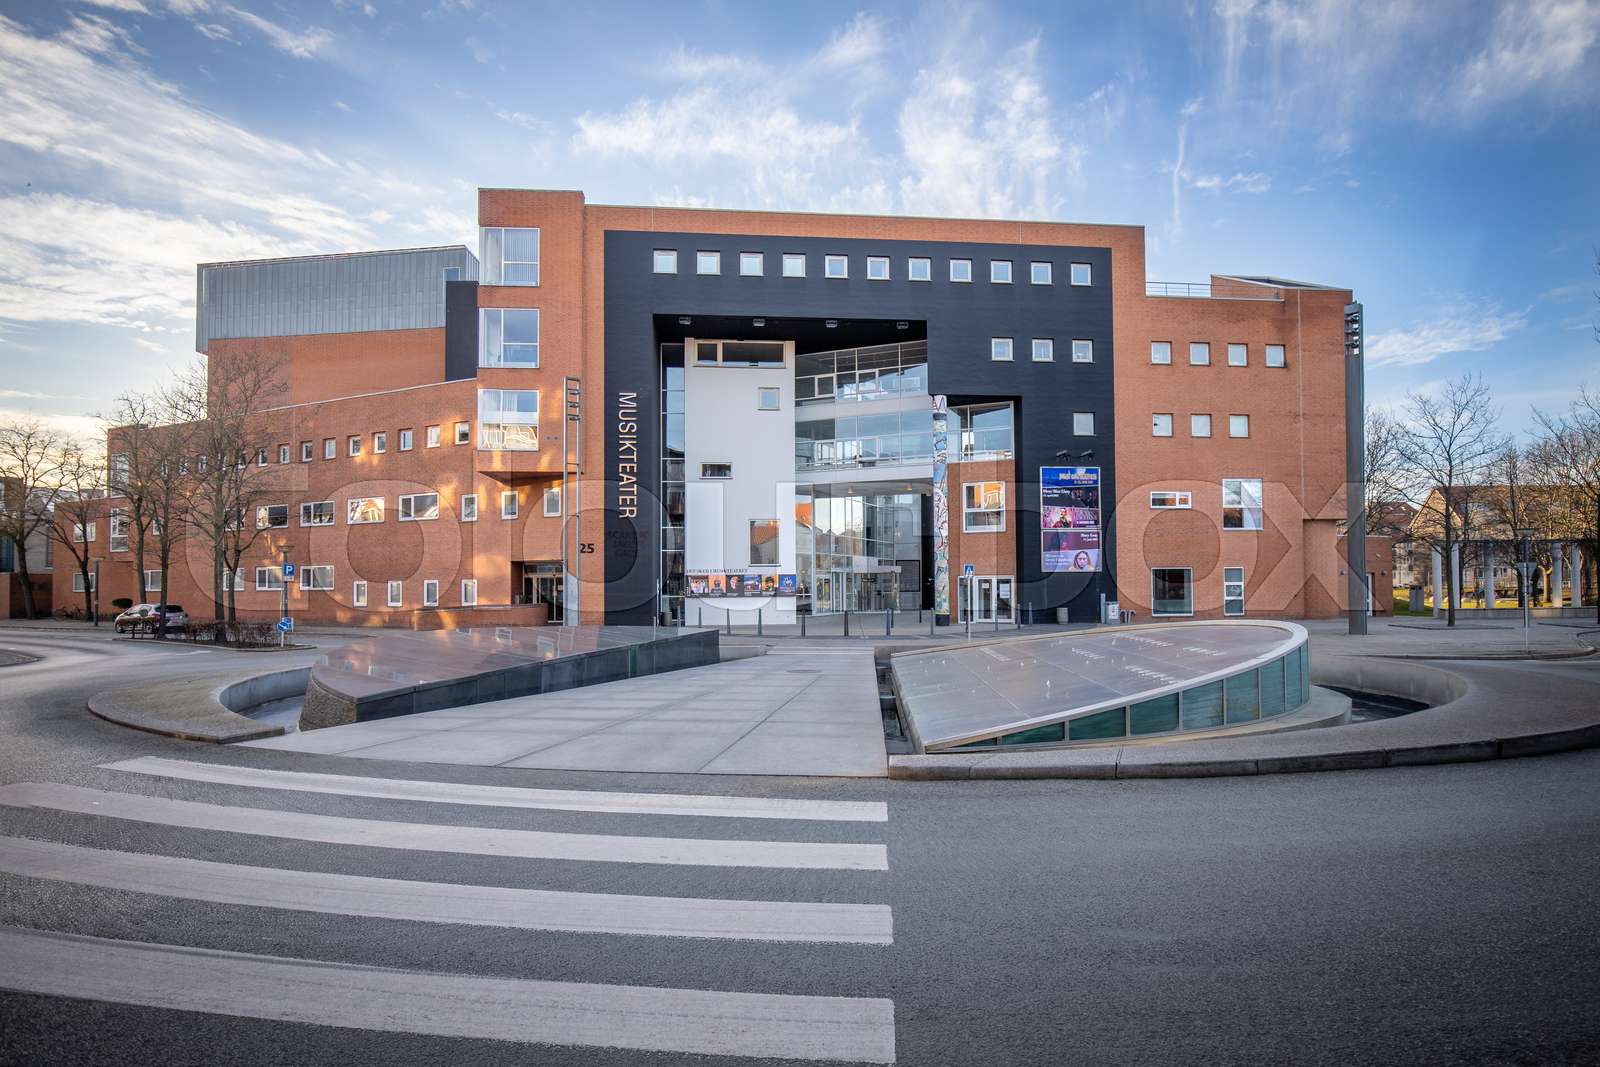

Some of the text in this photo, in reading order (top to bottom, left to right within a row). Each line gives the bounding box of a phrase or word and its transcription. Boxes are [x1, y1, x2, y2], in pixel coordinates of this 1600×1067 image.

[618, 392, 637, 518] MUSIKTEATER
[579, 543, 595, 554] 25
[286, 565, 293, 575] P
